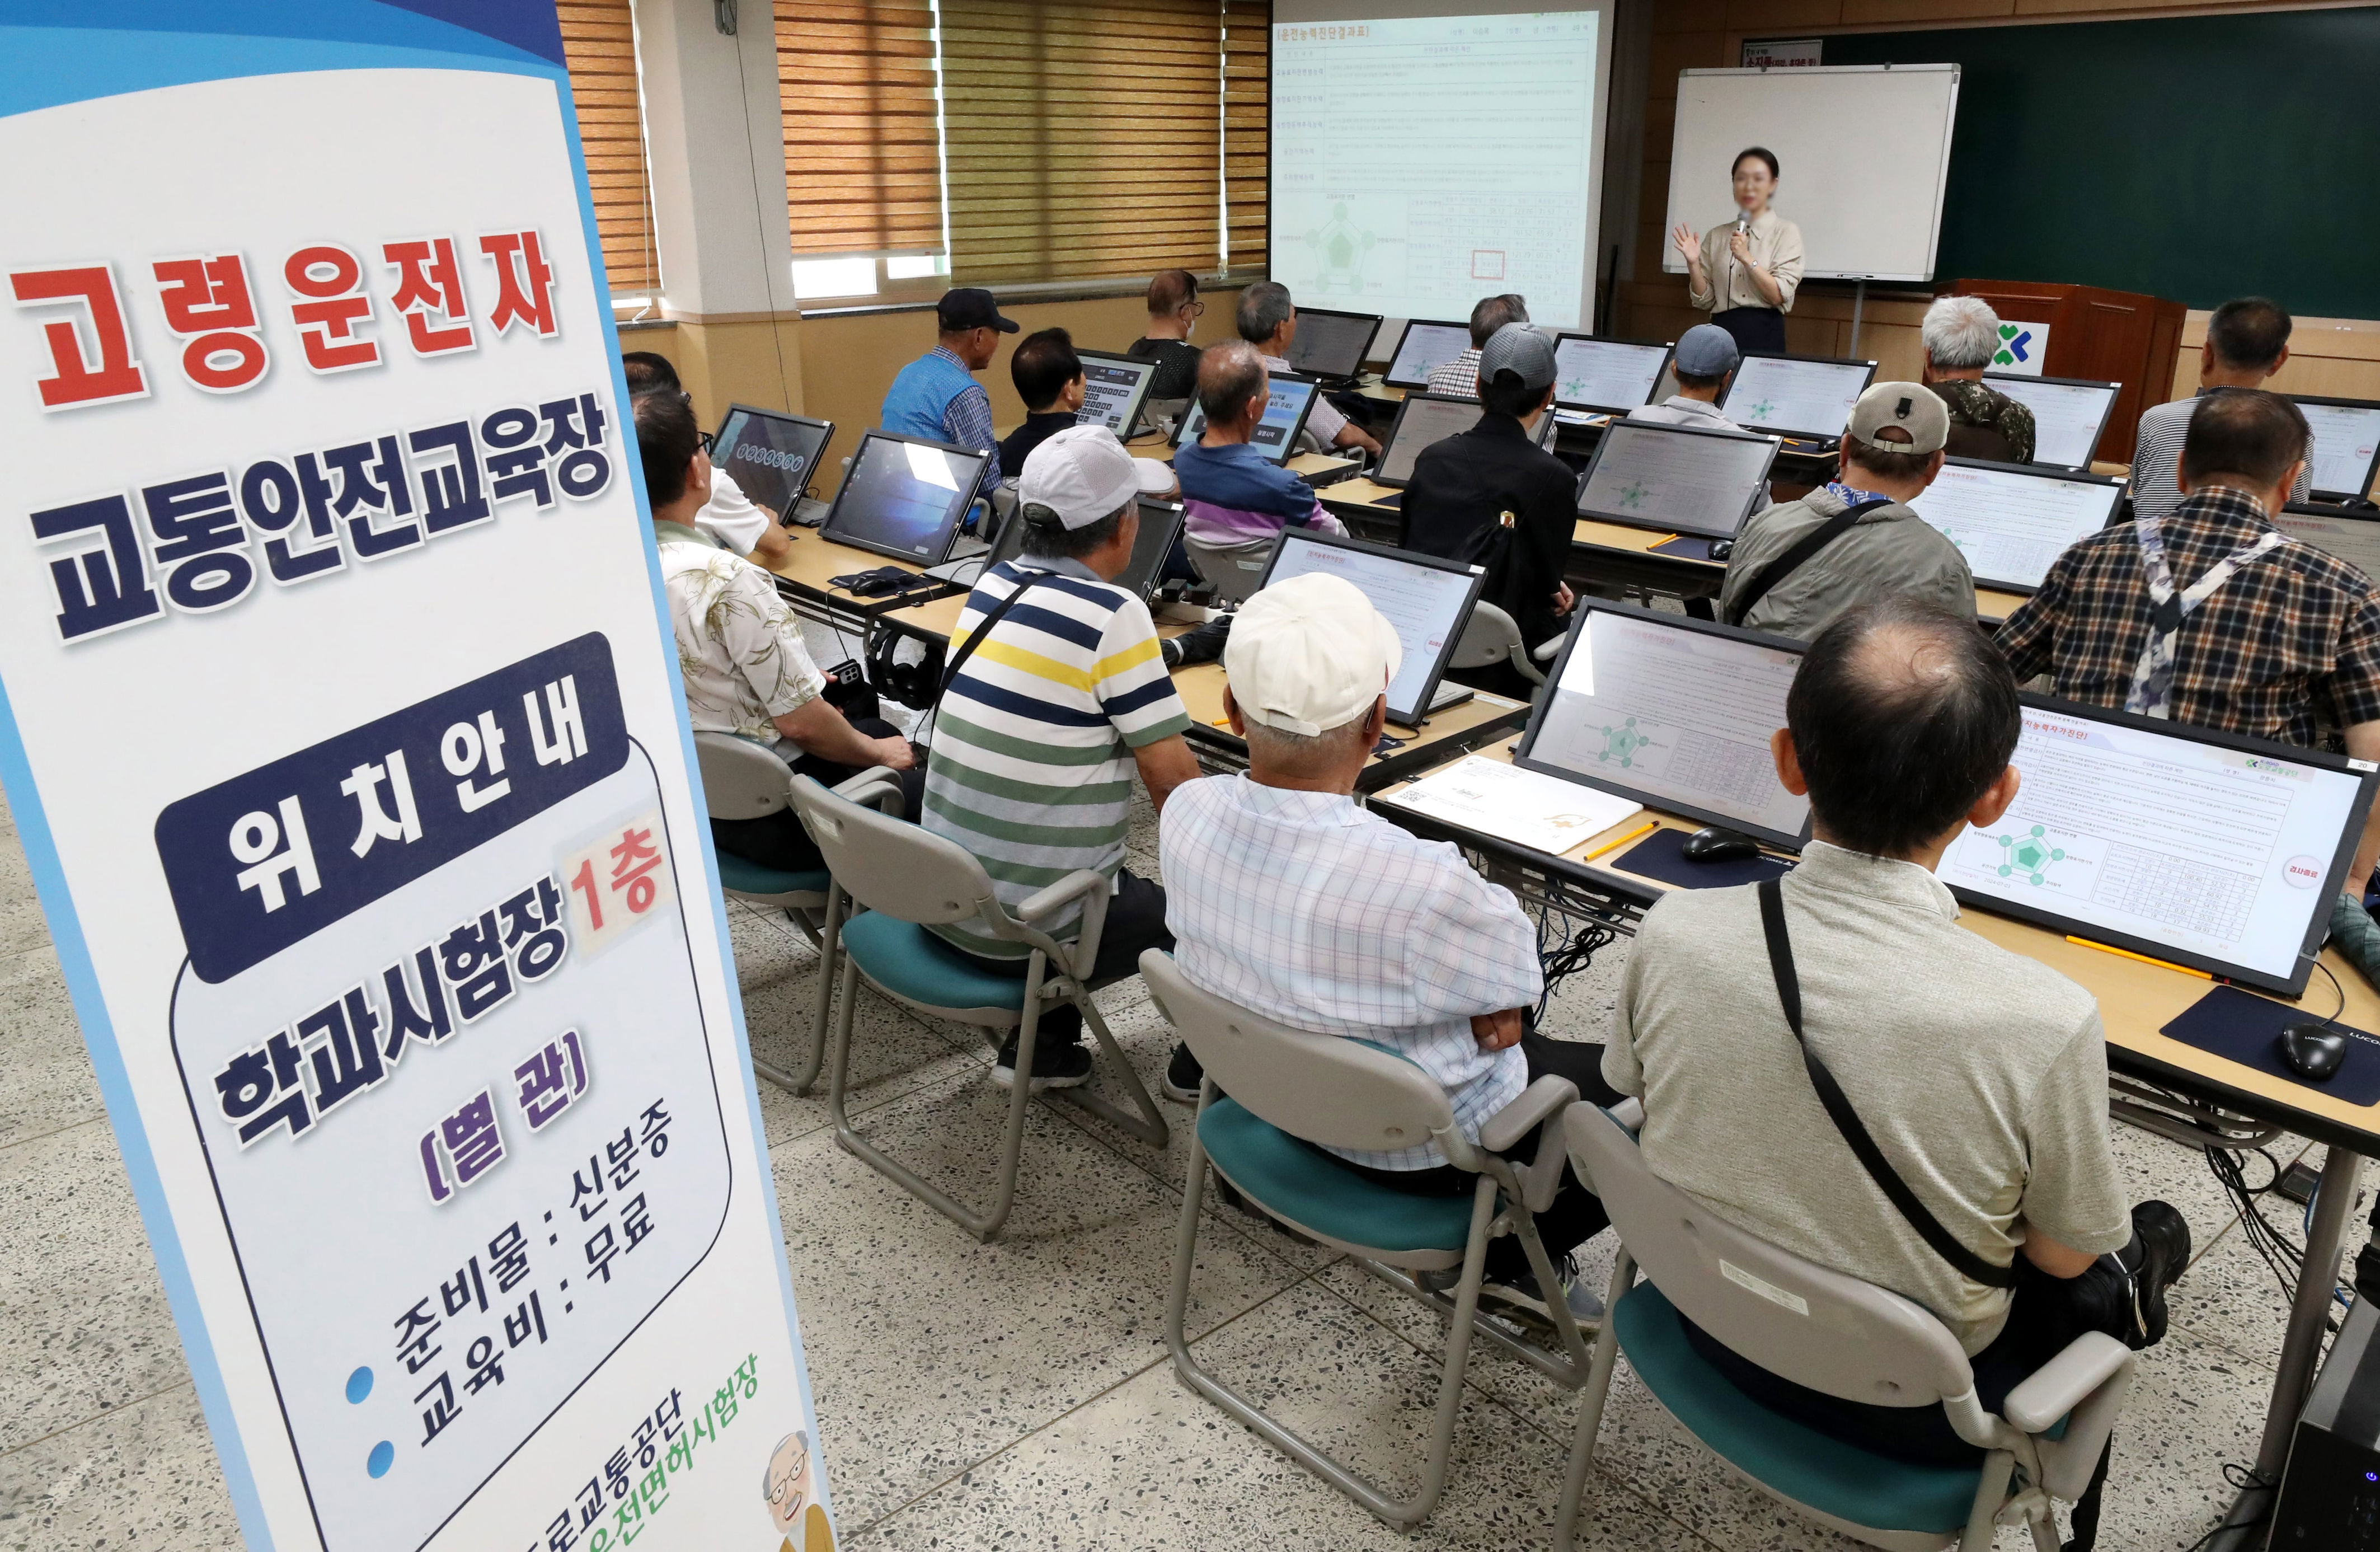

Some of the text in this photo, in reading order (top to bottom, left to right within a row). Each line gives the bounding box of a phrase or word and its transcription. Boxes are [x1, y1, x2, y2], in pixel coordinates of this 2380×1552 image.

[1278, 26, 1369, 41] [운전능력진단결과표]
[10, 230, 555, 407] 고령운전자
[30, 393, 610, 639] 교통안전교육장
[229, 674, 588, 913] 위치안내
[2021, 719, 2088, 740] 지능력자가진단]
[2289, 865, 2318, 878] 검사종료
[215, 828, 663, 1143] 학과시험장 1층
[2349, 1032, 2380, 1045] LUCO
[395, 1222, 531, 1374] 준비물
[570, 1098, 672, 1222] 신분증
[414, 1291, 548, 1447] 교육비
[584, 1192, 655, 1284] 무료
[528, 1388, 683, 1552] 로교통공단
